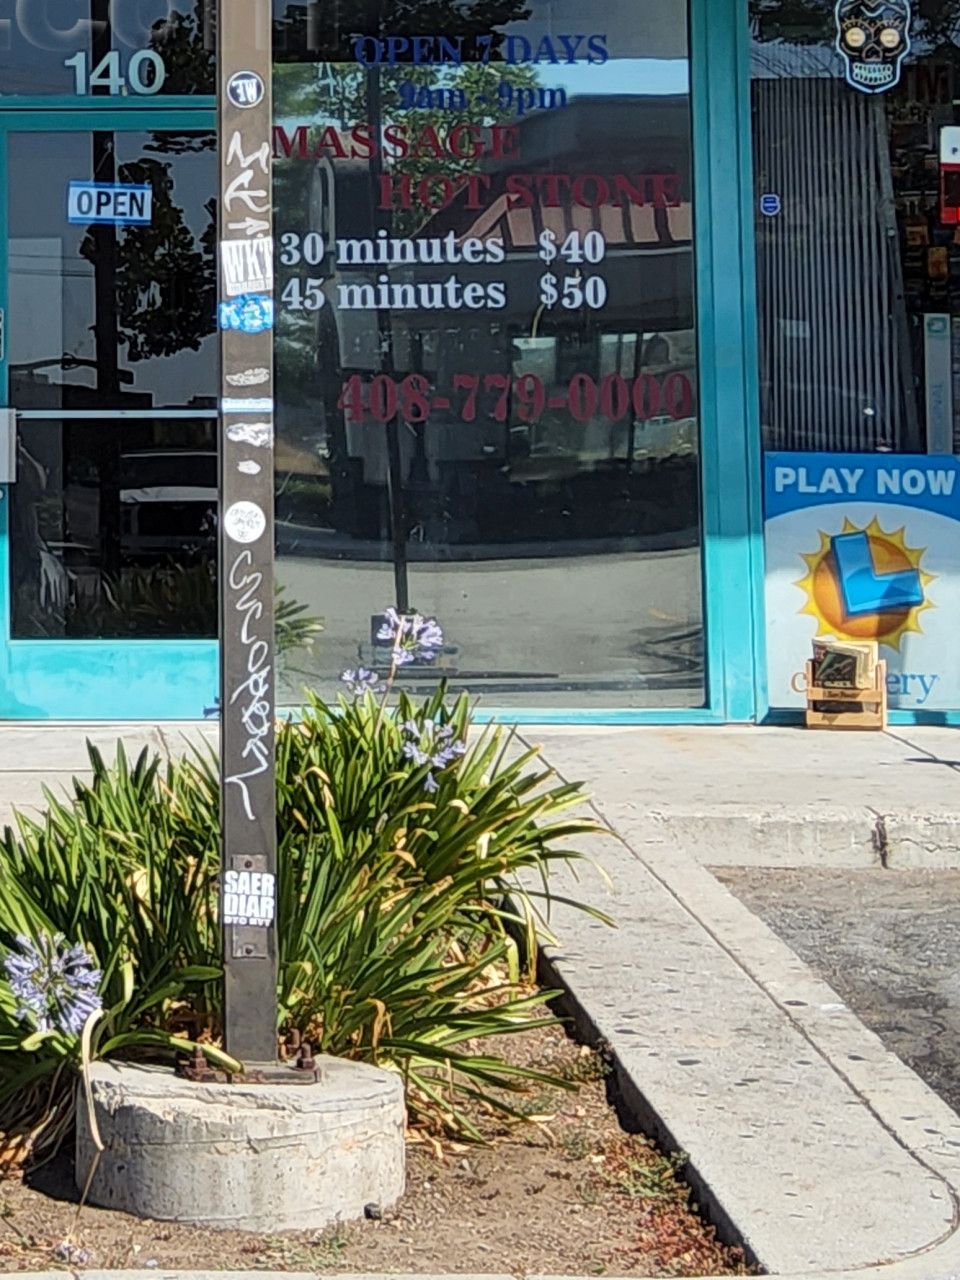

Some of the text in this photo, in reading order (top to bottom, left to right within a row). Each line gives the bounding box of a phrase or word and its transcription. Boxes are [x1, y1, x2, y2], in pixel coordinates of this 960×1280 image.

[353, 34, 609, 66] OPEN 7 DAYS
[63, 49, 166, 96] 140
[399, 81, 467, 110] 9am
[498, 81, 567, 115] 9pm
[272, 125, 520, 160] MASSAGE
[76, 190, 146, 218] OPEN
[379, 173, 682, 211] HOT STONE
[280, 227, 606, 266] 30 minutes $40
[280, 273, 607, 311] 45 minutes $50
[336, 373, 693, 423] 408-779-0000
[775, 467, 955, 496] PLAY NOW
